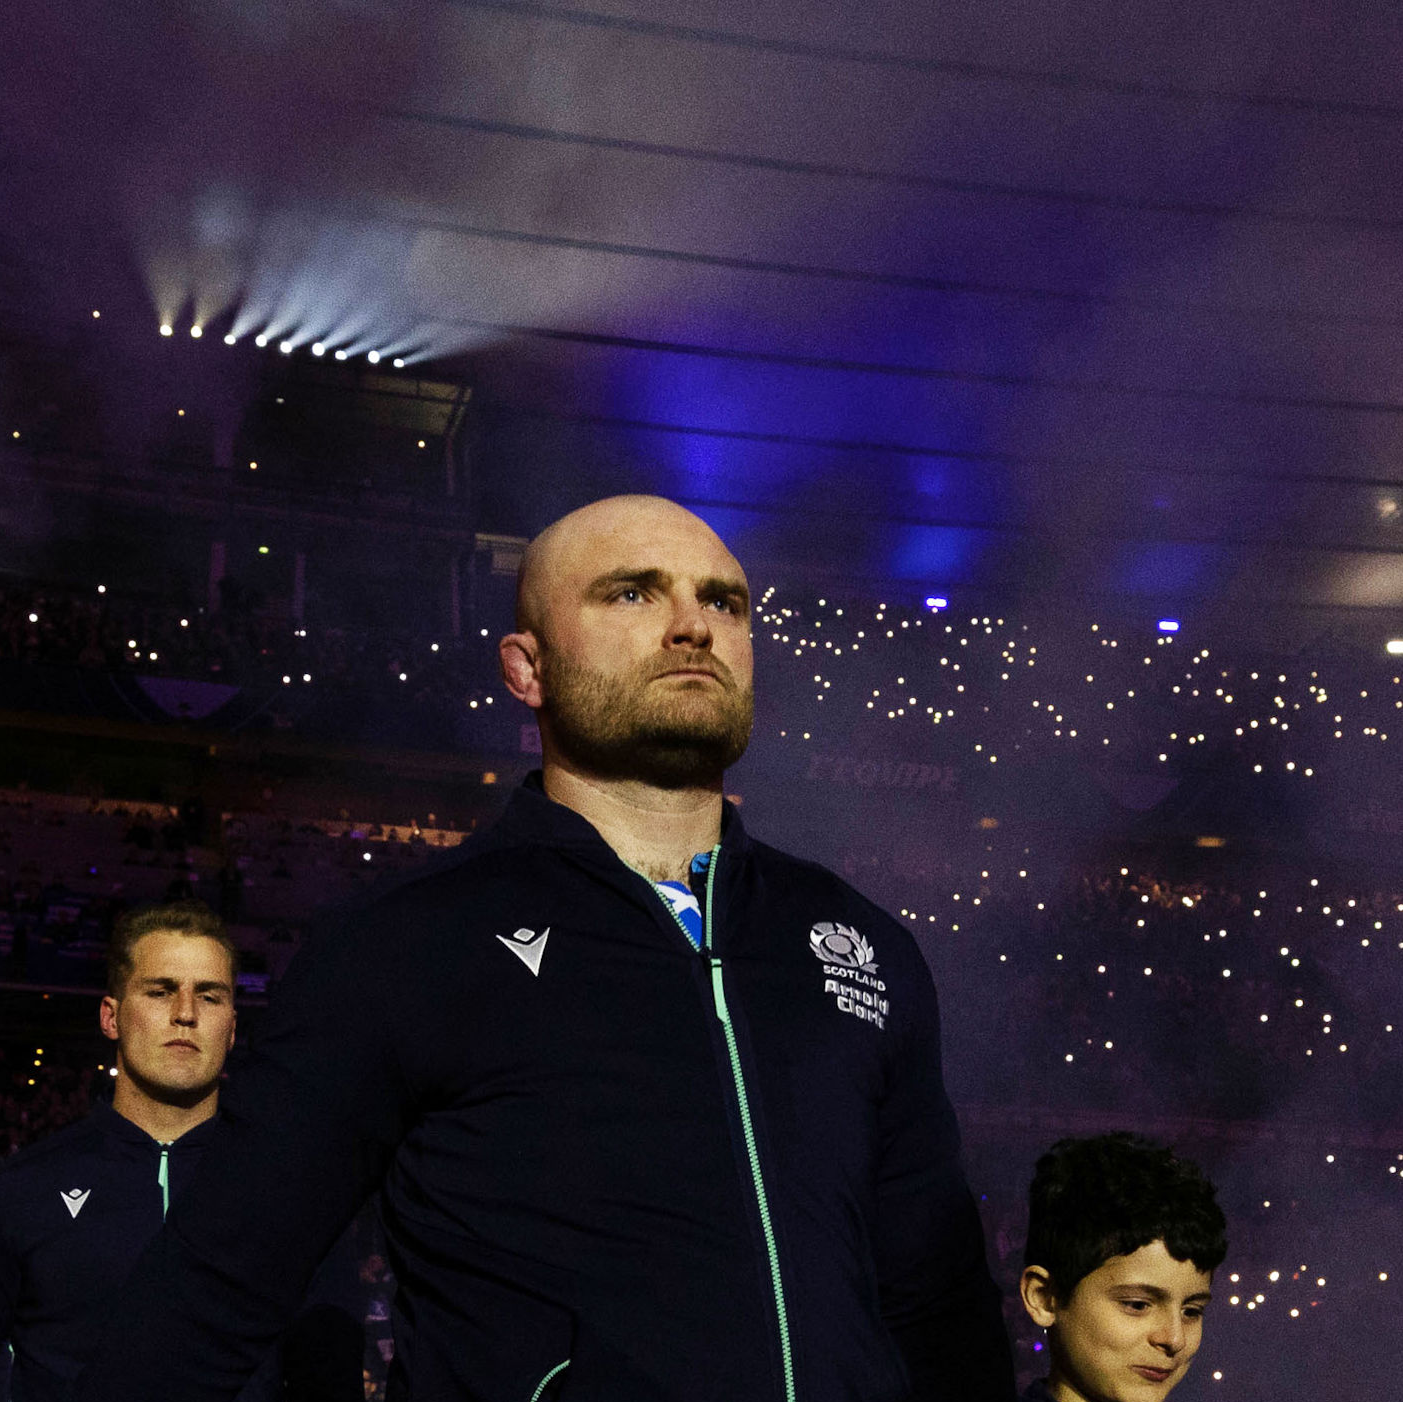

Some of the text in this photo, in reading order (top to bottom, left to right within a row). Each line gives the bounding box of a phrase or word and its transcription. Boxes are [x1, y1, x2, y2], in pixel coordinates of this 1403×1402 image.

[823, 964, 886, 991] SCOTLAND
[824, 979, 889, 1016] Arnold
[837, 995, 886, 1031] Clark
